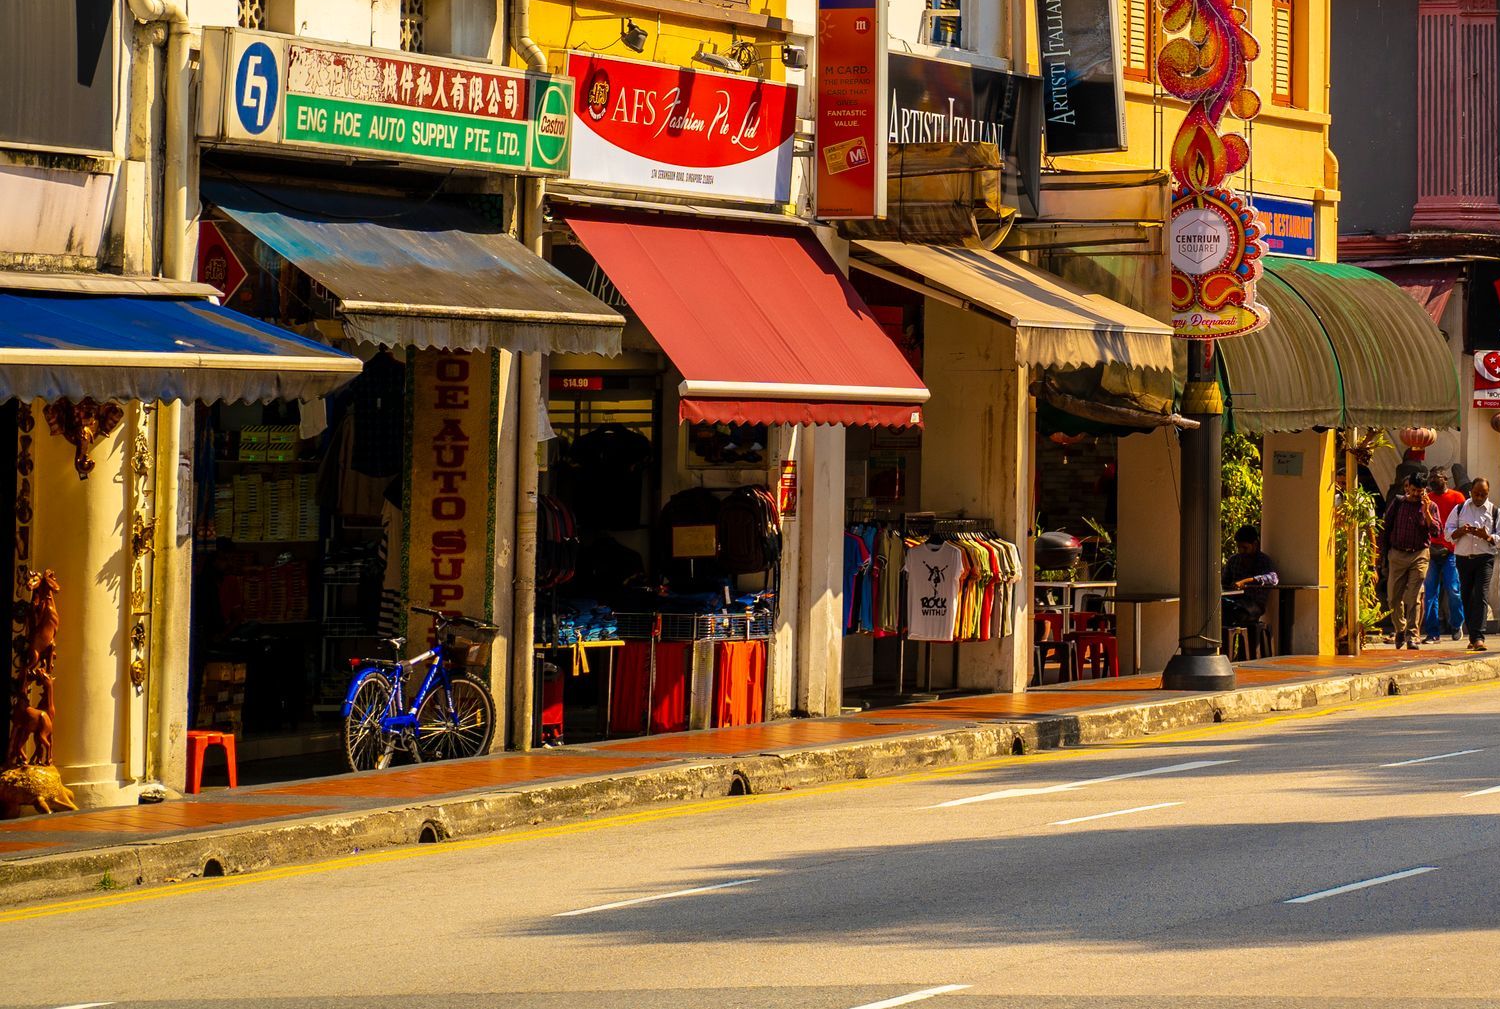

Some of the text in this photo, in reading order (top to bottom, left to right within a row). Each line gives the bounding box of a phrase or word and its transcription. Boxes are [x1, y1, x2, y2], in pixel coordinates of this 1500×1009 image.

[1047, 62, 1076, 126] ARTISTI
[540, 115, 566, 137] Castrol
[611, 87, 656, 125] AFS
[654, 87, 704, 139] Fashion
[731, 102, 760, 151] Ltd
[889, 88, 945, 143] ARTISTI
[297, 106, 520, 157] ENG HOE AUTO SUPPLY PTE. LTD.
[1273, 213, 1313, 240] RESTAURANT
[1176, 235, 1220, 243] CENTRIUM
[1181, 244, 1214, 253] SQUARE
[1191, 314, 1237, 327] Deepavali
[563, 378, 588, 388] $14.90
[432, 419, 470, 521] AUTO
[920, 597, 947, 609] ROCK
